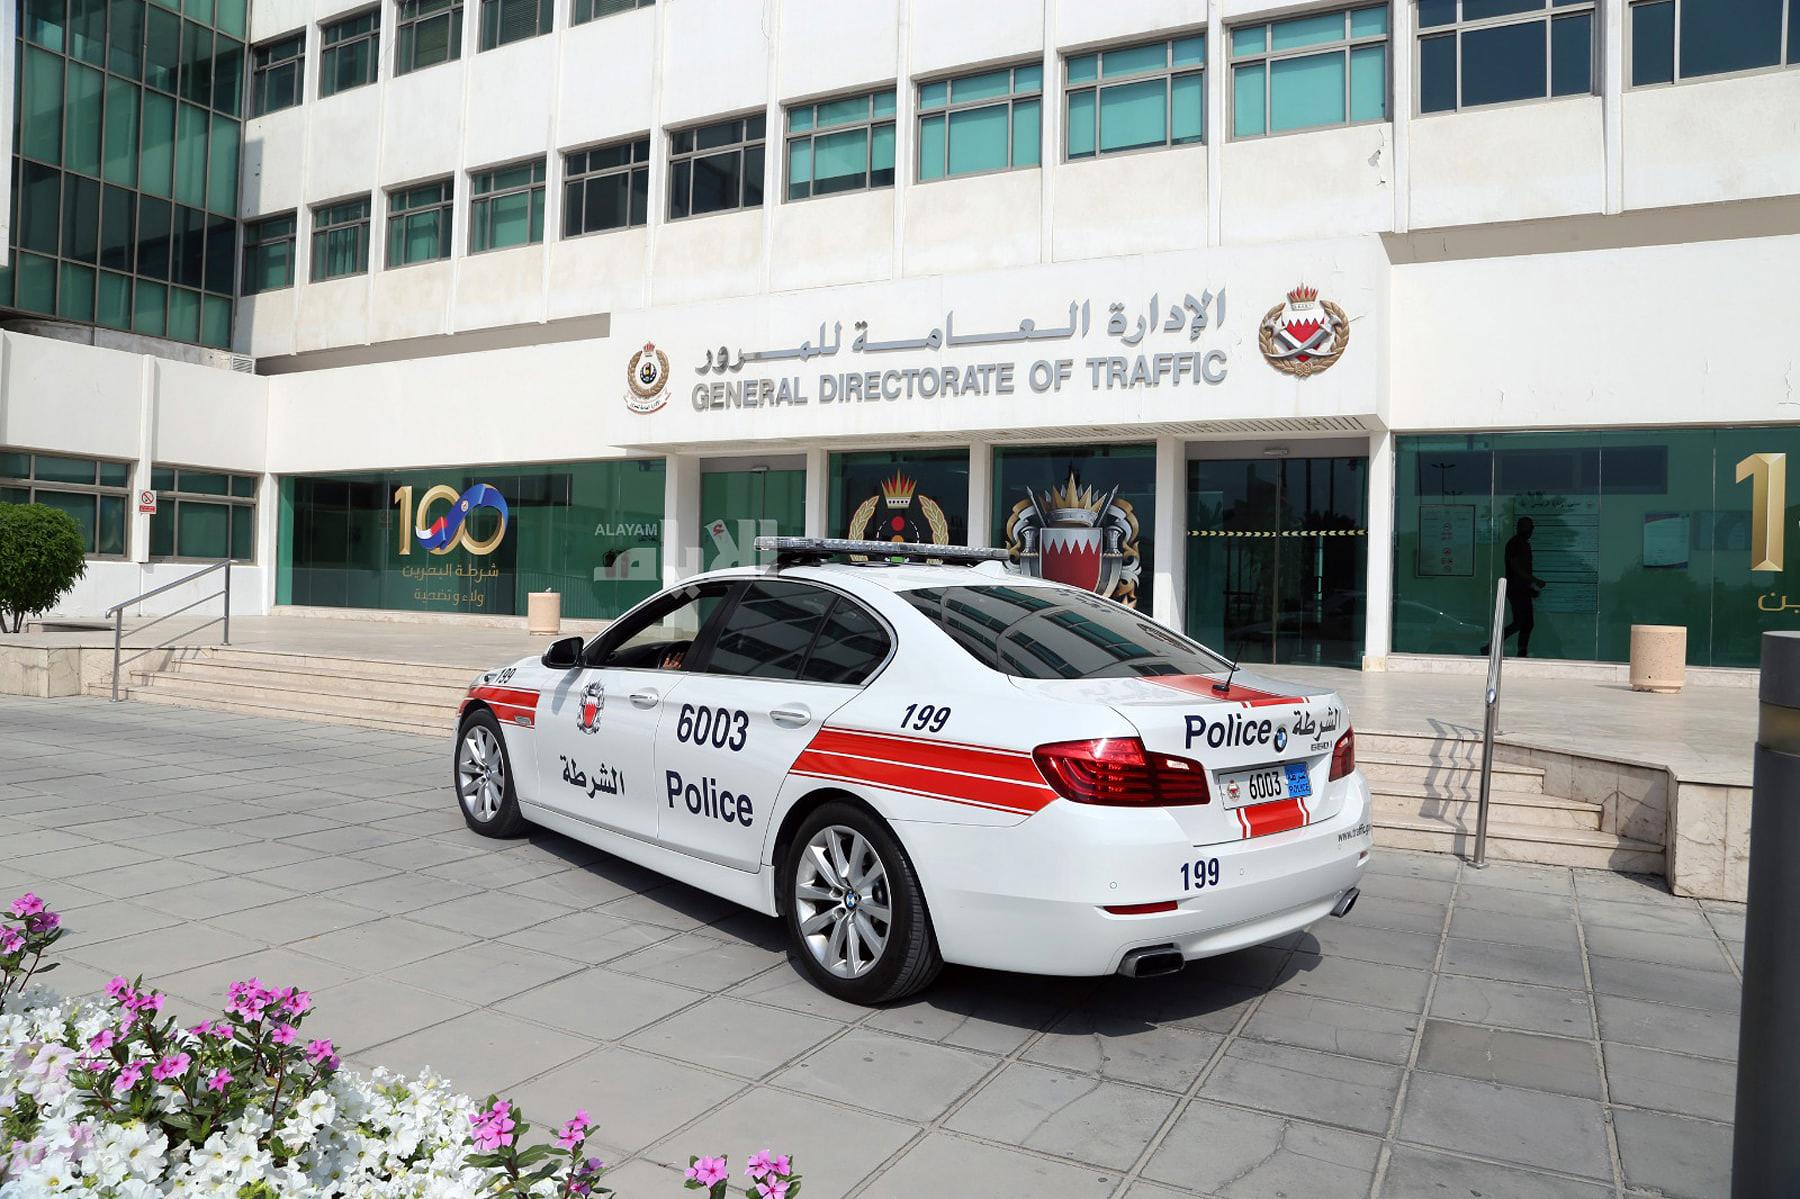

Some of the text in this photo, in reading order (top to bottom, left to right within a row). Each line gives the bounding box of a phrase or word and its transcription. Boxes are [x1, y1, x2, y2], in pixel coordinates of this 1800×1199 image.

[694, 287, 1227, 377] الإدارة العامة للمرور
[691, 349, 1228, 412] GENERAL DIRECTORATE OF TRAFFIC
[394, 483, 509, 556] 100
[402, 562, 499, 583] شرطة البحرين
[496, 667, 517, 684] 199
[676, 703, 749, 752] 6003
[900, 703, 951, 733] 199
[1184, 713, 1272, 750] Police
[1291, 706, 1341, 741] الشرطة
[559, 754, 625, 799] الشرطة
[1249, 771, 1282, 799] 6003
[665, 769, 754, 827] Police
[1180, 857, 1220, 891] 199
